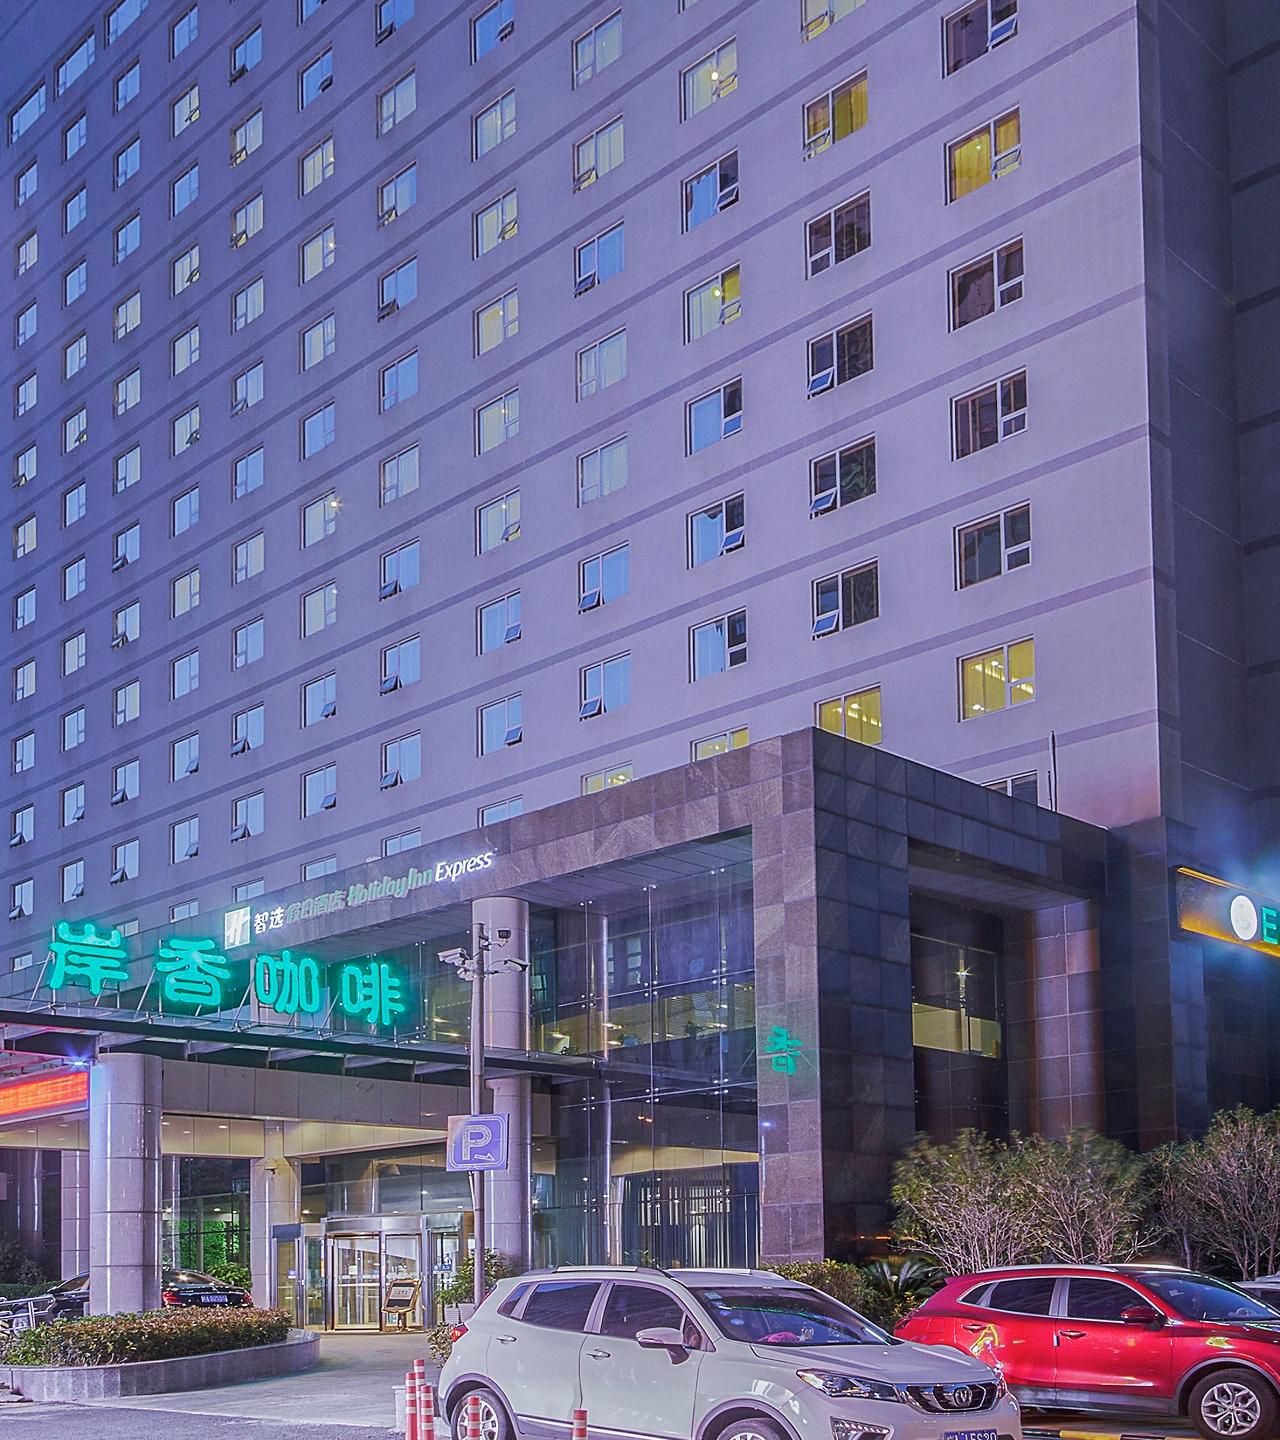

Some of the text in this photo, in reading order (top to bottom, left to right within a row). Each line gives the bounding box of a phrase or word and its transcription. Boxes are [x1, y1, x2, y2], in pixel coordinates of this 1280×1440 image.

[253, 851, 493, 935] 智选假日酒店 Holiday Inn Express
[47, 920, 406, 1026] 岸香咖啡
[462, 1125, 492, 1161] P
